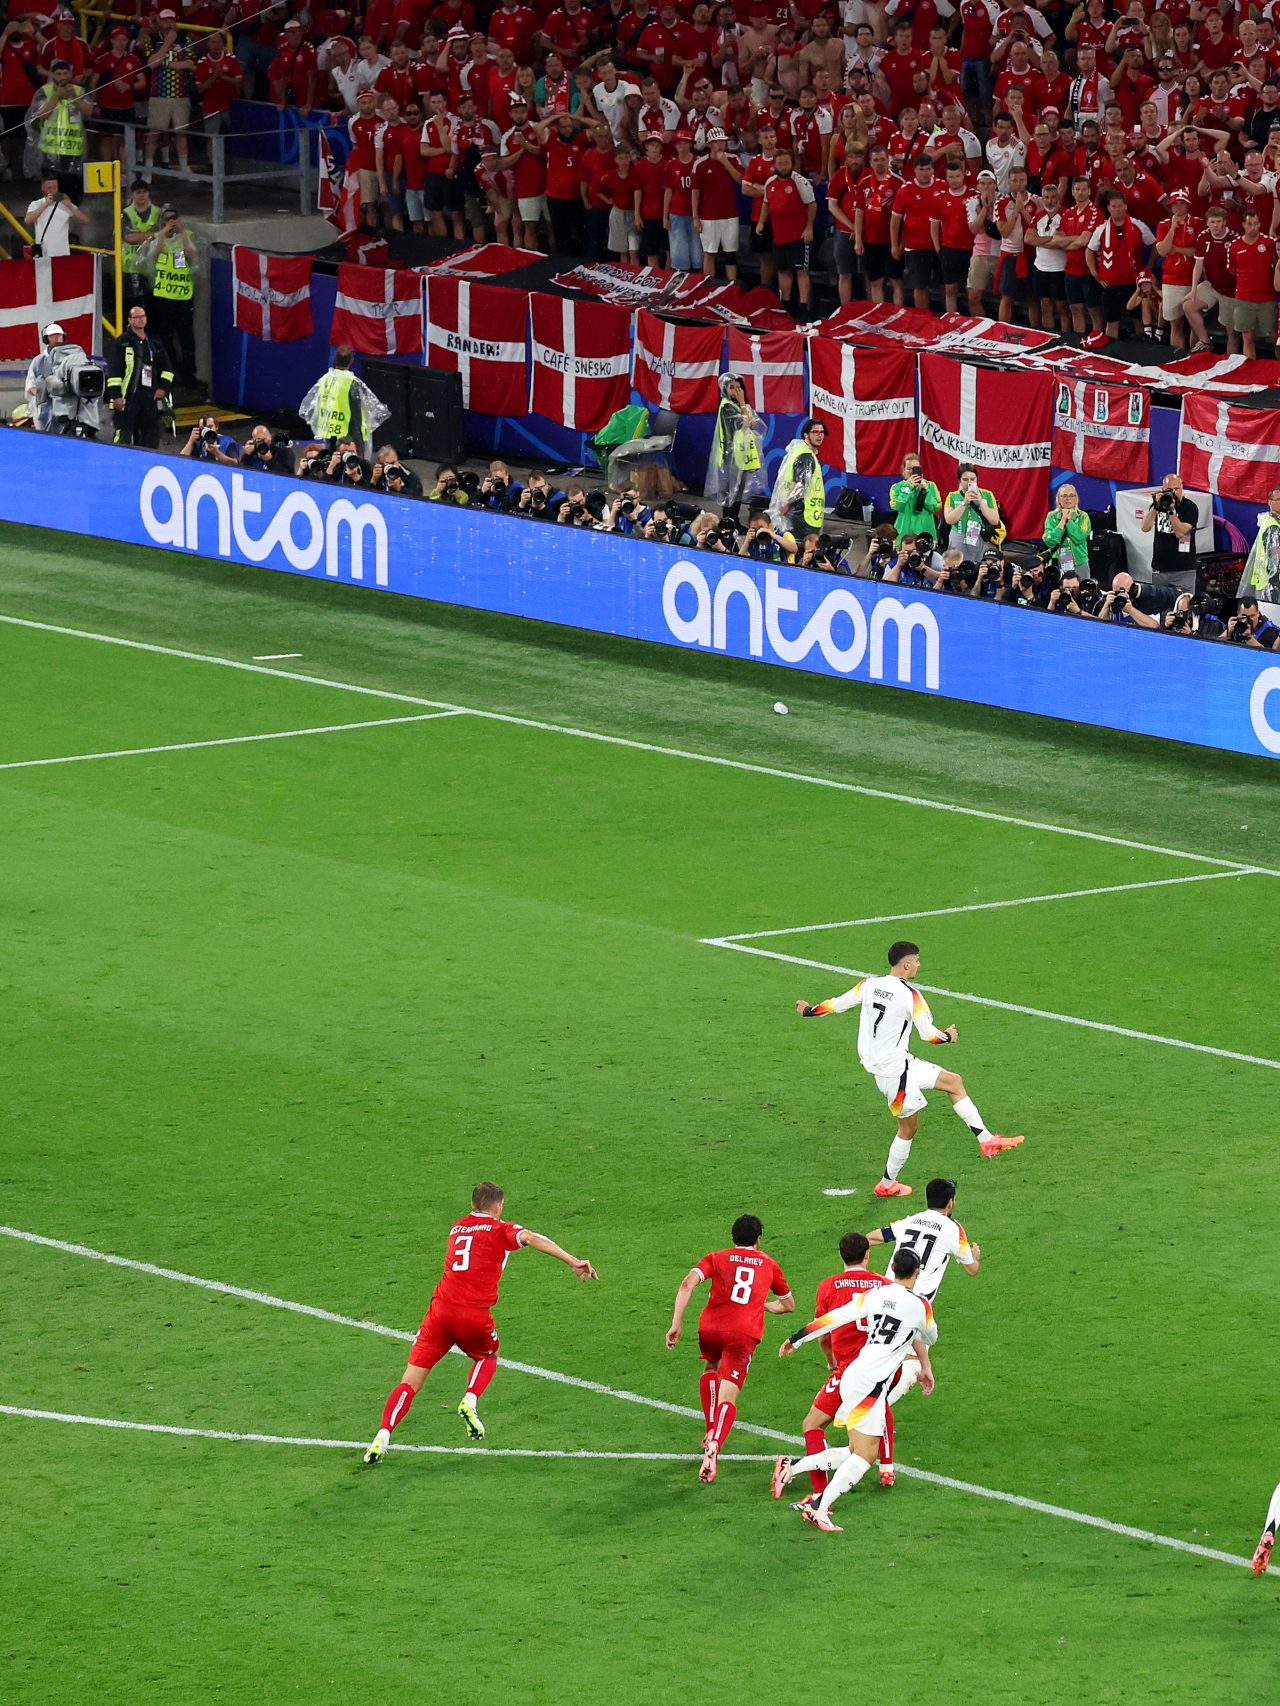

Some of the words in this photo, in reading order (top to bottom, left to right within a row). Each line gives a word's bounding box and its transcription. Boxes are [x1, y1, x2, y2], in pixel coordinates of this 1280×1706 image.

[543, 350, 569, 372] CAFÉ
[574, 362, 612, 377] SNESKO
[813, 389, 835, 411] KANE
[854, 402, 890, 416] TROPHY
[891, 401, 911, 414] OUT
[140, 465, 389, 587] antom
[662, 560, 940, 690] antom
[872, 1002, 887, 1038] 7
[452, 1235, 473, 1272] 3
[899, 1228, 938, 1271] 21
[730, 1266, 755, 1304] 8
[868, 1313, 902, 1345] 19
